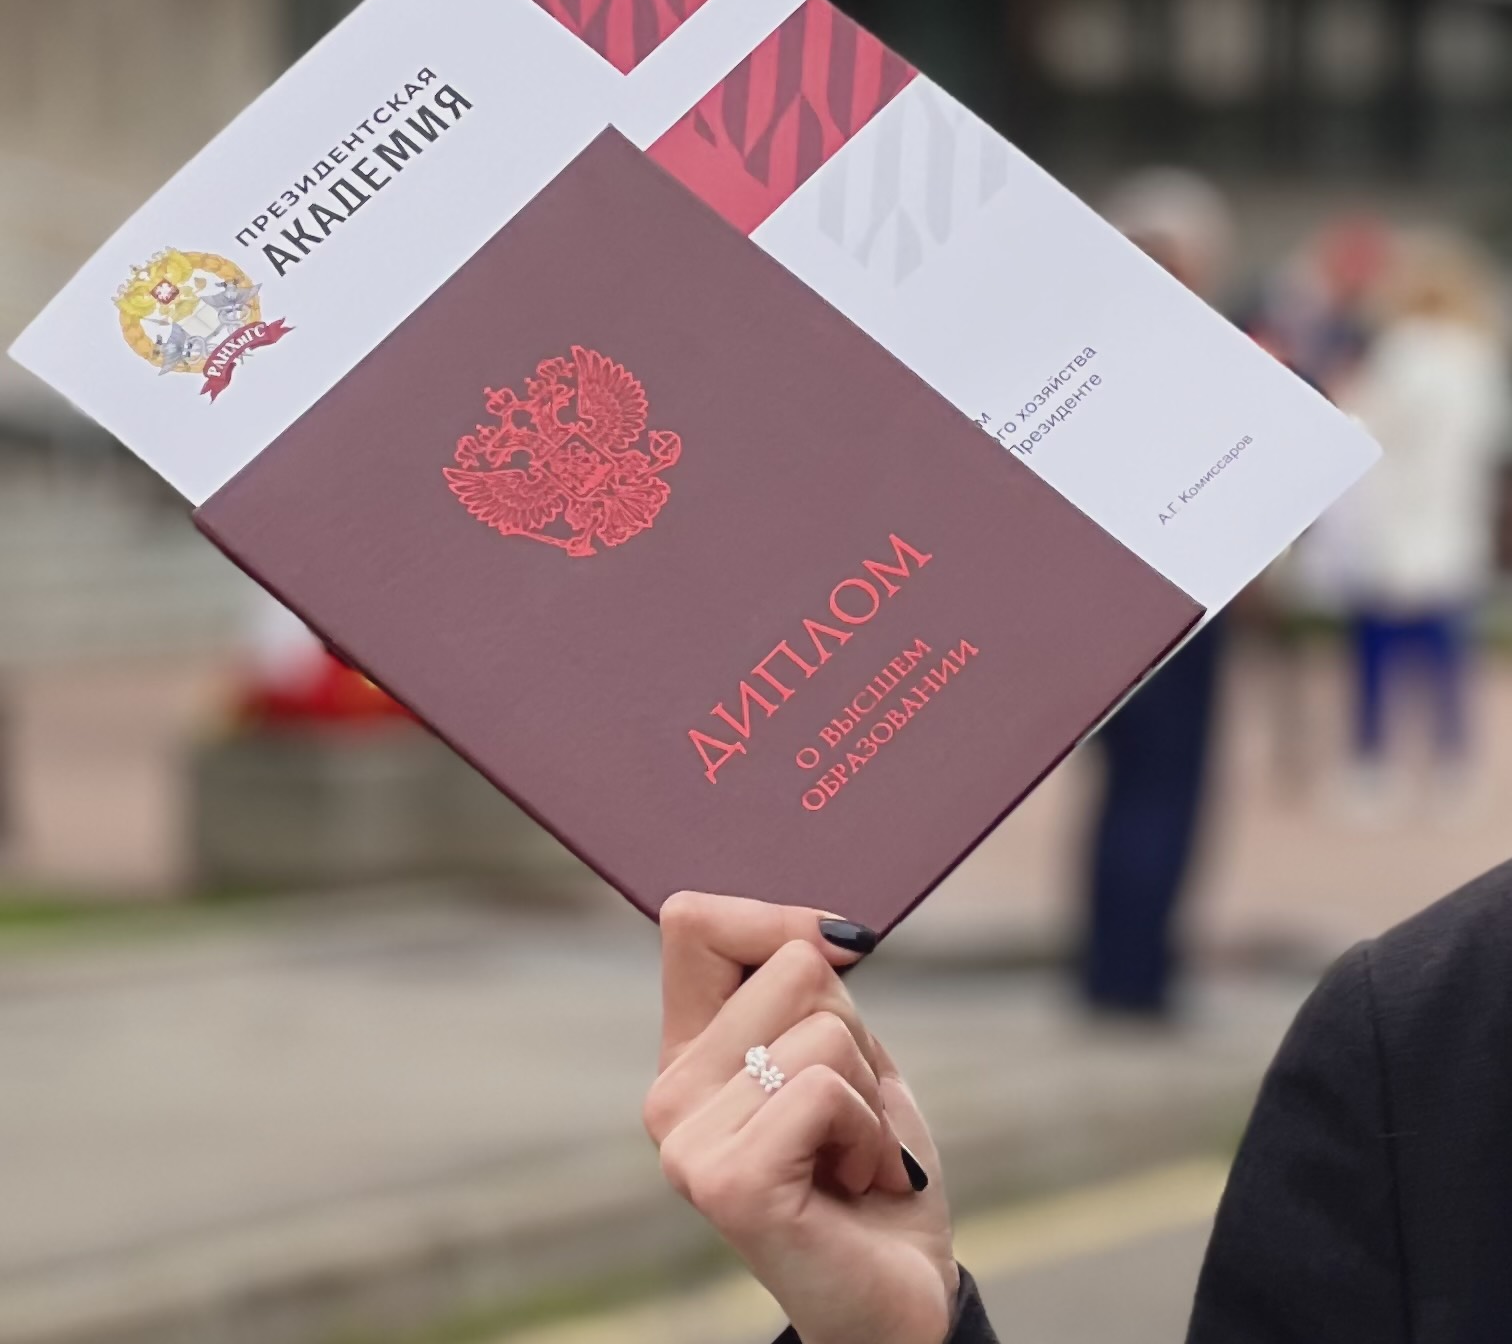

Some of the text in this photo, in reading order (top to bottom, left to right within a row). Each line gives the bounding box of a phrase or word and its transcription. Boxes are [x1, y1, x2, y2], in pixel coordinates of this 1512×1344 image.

[235, 67, 437, 247] ПРЕЗИДЕНТСКАЯ
[262, 84, 473, 277] АКАДЕМИЯ
[1015, 346, 1098, 422] хозяйства
[1177, 435, 1254, 504] Комиссаров
[688, 533, 933, 785] ДИПЛОМ
[795, 638, 933, 769] О ВЫСШЕМ
[801, 639, 980, 811] ОБРАЗОВАНИИ
